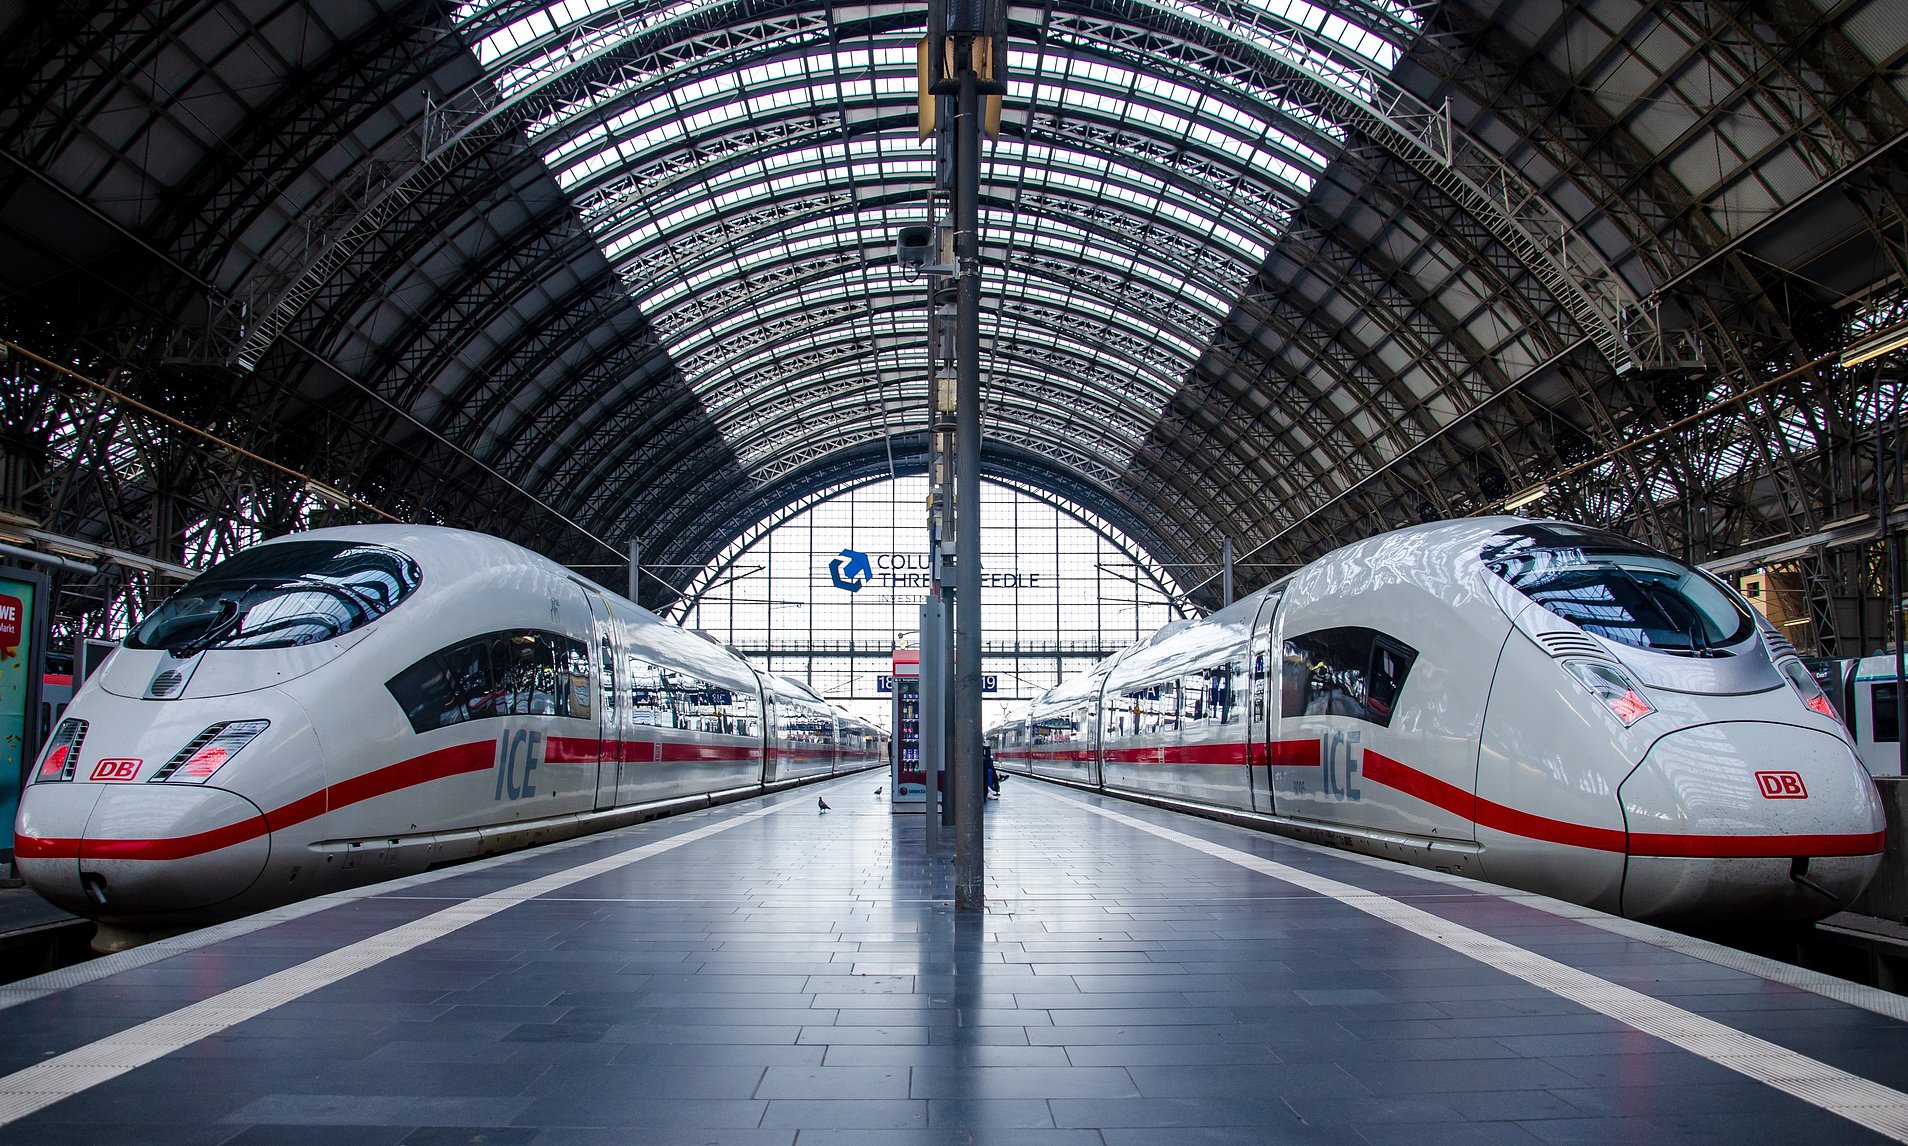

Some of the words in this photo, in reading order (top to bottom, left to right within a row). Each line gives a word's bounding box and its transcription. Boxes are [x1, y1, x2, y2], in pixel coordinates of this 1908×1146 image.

[878, 573, 1040, 588] THREEEDLE
[879, 676, 892, 689] 18
[982, 676, 995, 689] 19
[96, 761, 135, 777] DB
[495, 729, 541, 800] ICE
[1323, 730, 1360, 801] ICE
[1761, 775, 1801, 794] DB
